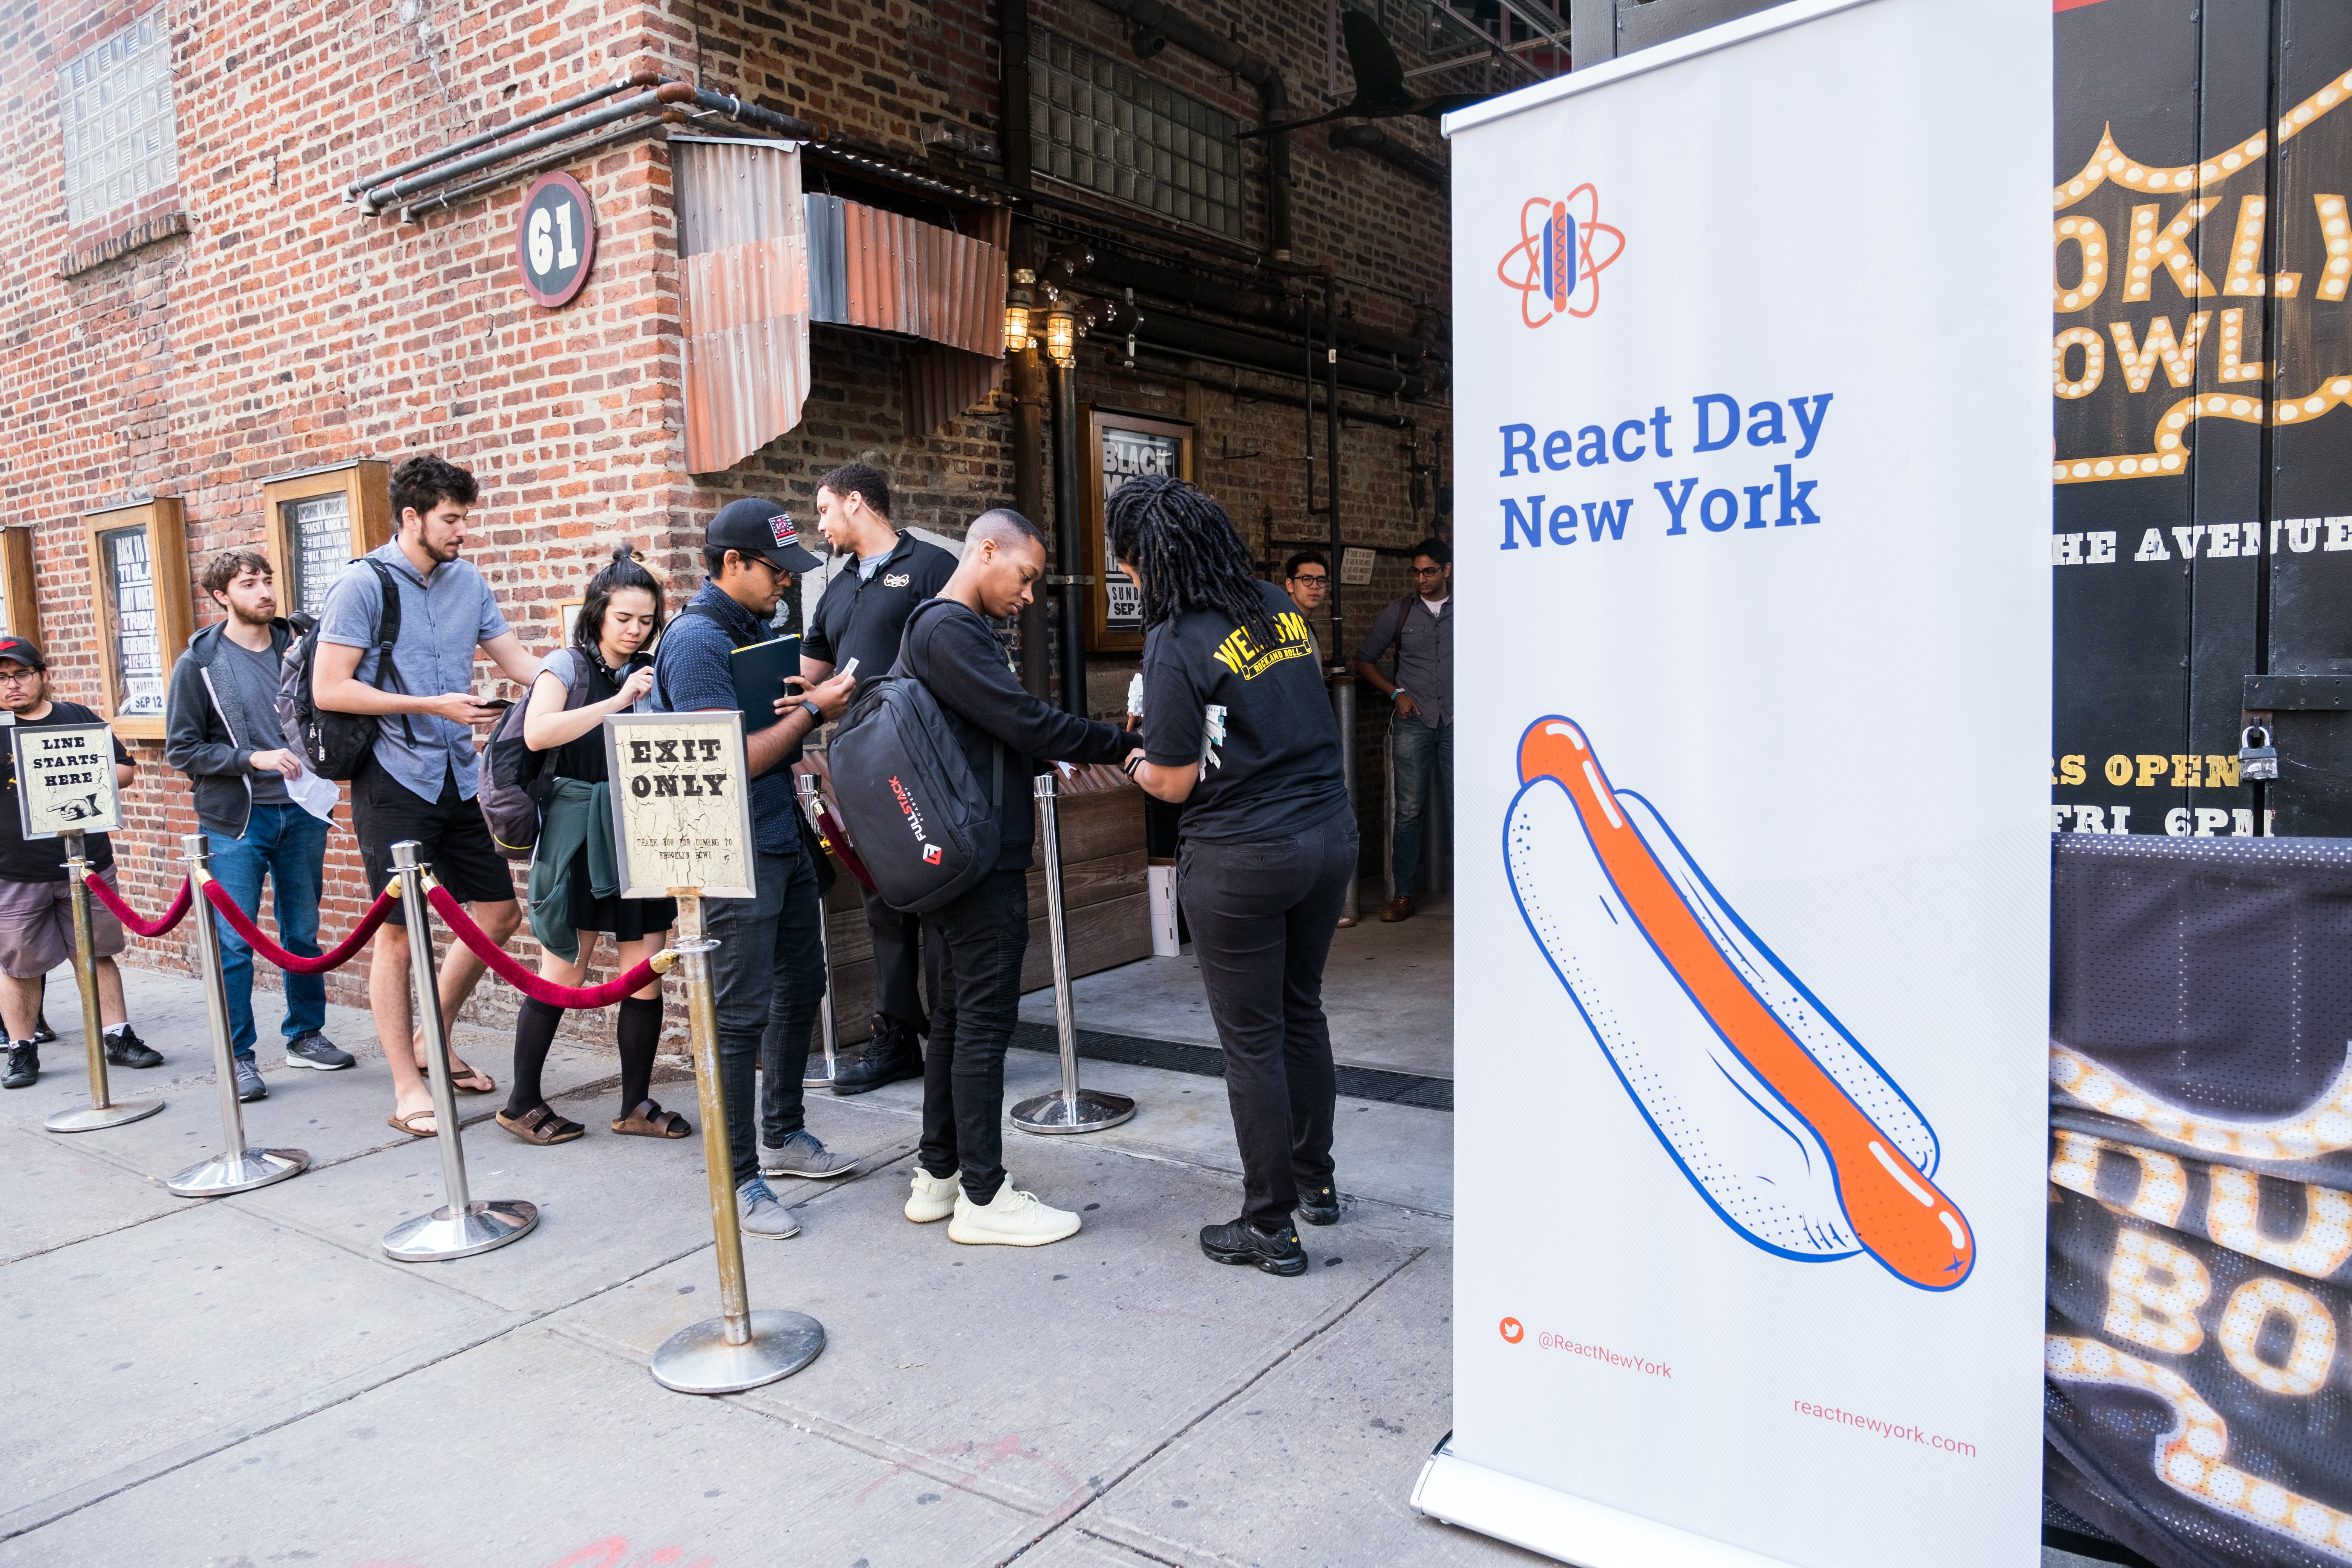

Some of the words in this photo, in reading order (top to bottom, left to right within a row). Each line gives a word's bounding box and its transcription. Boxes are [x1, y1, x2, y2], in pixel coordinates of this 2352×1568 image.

[528, 201, 577, 275] 61
[2053, 308, 2276, 399] OWL
[1499, 406, 1673, 477] React
[1693, 392, 1833, 459] Day
[1103, 442, 1168, 475] BLACK
[1500, 495, 1634, 550] New
[1654, 464, 1821, 536] York
[305, 521, 324, 534] YACHT
[324, 518, 342, 531] ROCK
[116, 536, 135, 565] BACK
[133, 534, 144, 562] TO
[2134, 516, 2352, 562] AVENUE
[307, 550, 320, 562] WAX
[320, 548, 339, 560] TAILOR
[118, 564, 131, 582] TO
[131, 561, 152, 581] BLA
[120, 587, 134, 612] AMY
[1112, 586, 1139, 600] SUND
[121, 610, 156, 631] TRIBU
[1114, 602, 1135, 616] SEP
[133, 681, 161, 694] THURSDAY
[135, 696, 150, 708] SEP
[153, 695, 162, 708] 12
[42, 737, 85, 750] LINE
[630, 739, 721, 763] EXIT
[33, 754, 98, 769] STARTS
[2105, 754, 2240, 787] OPEN
[44, 772, 92, 787] HERE
[632, 774, 727, 798] ONLY
[888, 775, 926, 842] FULLSTACK
[905, 787, 923, 821] ACADEMY
[2052, 805, 2130, 835] FRI
[637, 838, 658, 847] THANK
[724, 838, 732, 846] TO
[2104, 1227, 2337, 1395] BO
[1539, 1331, 1672, 1379] @ReactNewYork
[1794, 1400, 1977, 1458] reactnewyork.com
